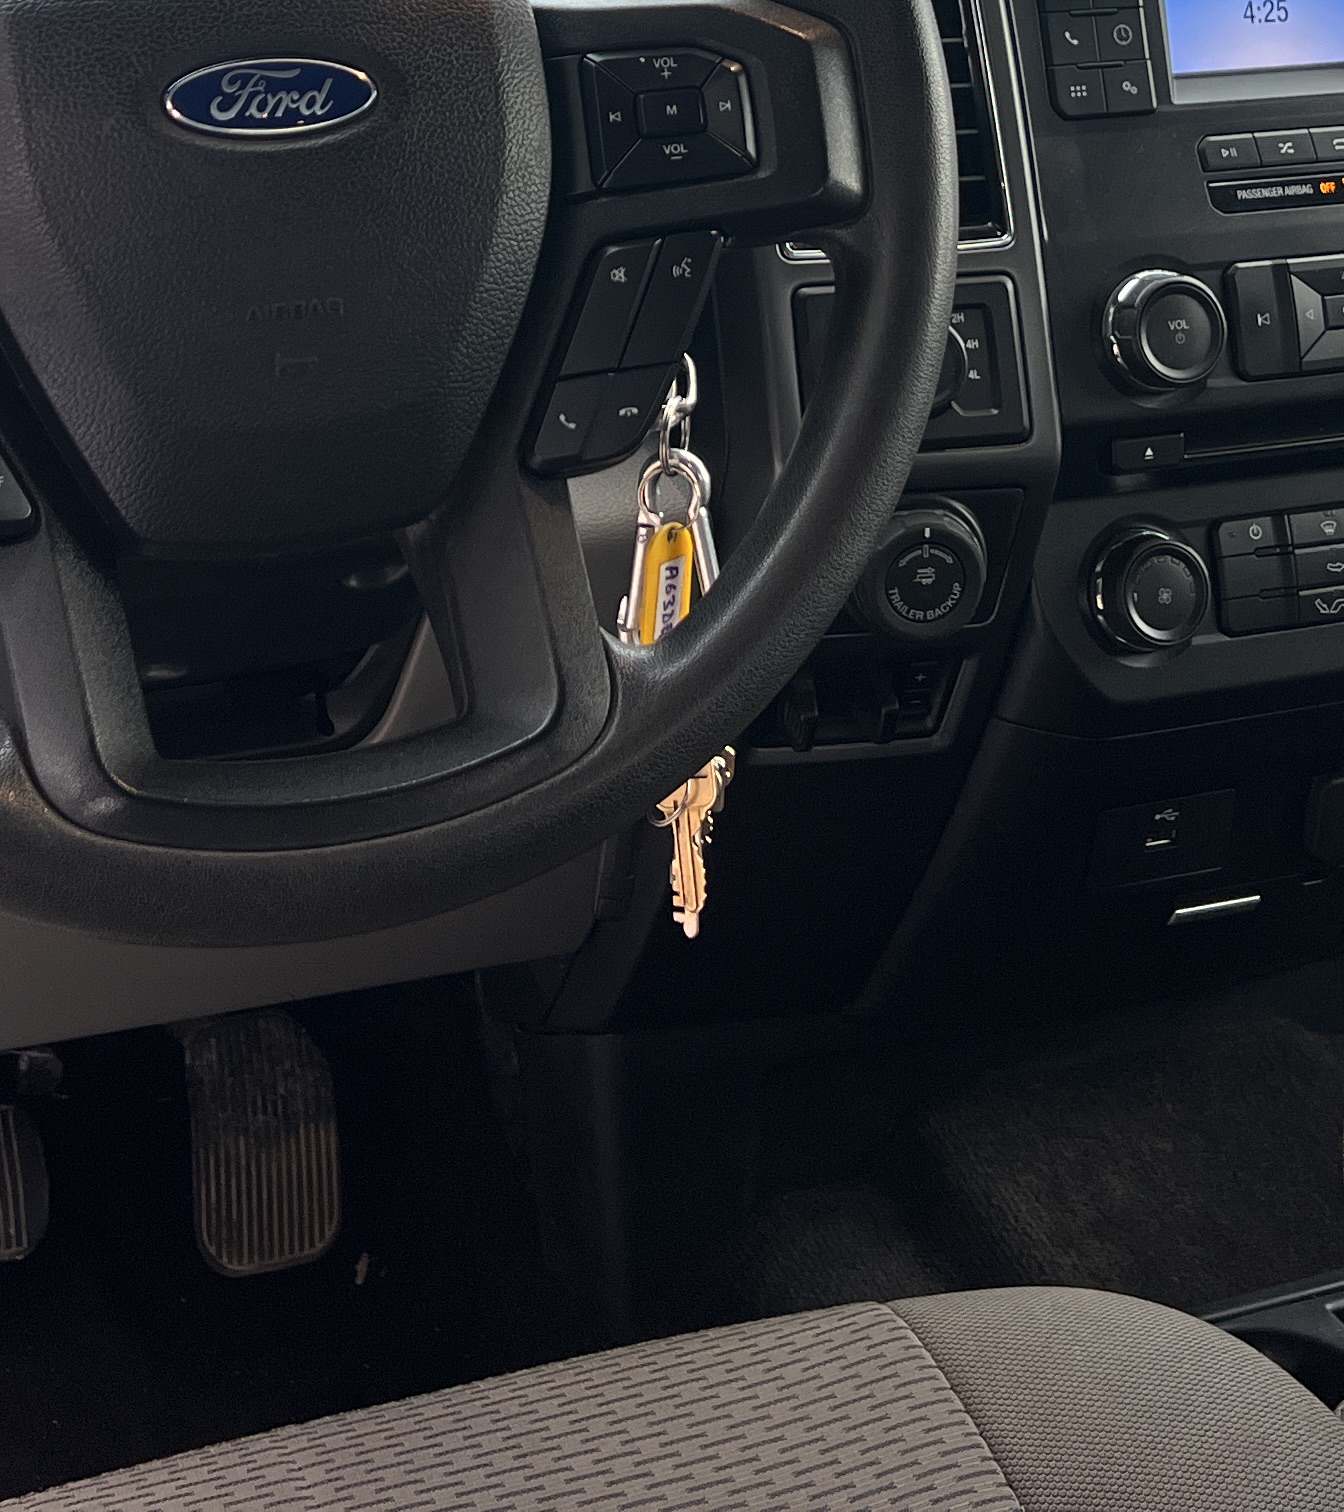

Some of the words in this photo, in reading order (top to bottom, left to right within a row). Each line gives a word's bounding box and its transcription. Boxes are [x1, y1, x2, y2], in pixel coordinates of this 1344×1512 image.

[652, 56, 678, 69] VOL
[209, 67, 335, 122] Ford
[665, 104, 678, 116] M
[662, 142, 689, 155] VOL
[1236, 186, 1285, 200] PASSENGER
[1284, 183, 1314, 197] AIRBAG
[1319, 181, 1337, 194] OFF
[950, 312, 965, 324] 2H
[1167, 319, 1190, 331] VOL
[966, 338, 979, 349] 4H
[968, 369, 981, 380] 4L
[888, 586, 924, 621] TRAILER
[926, 582, 963, 620] BACKUP
